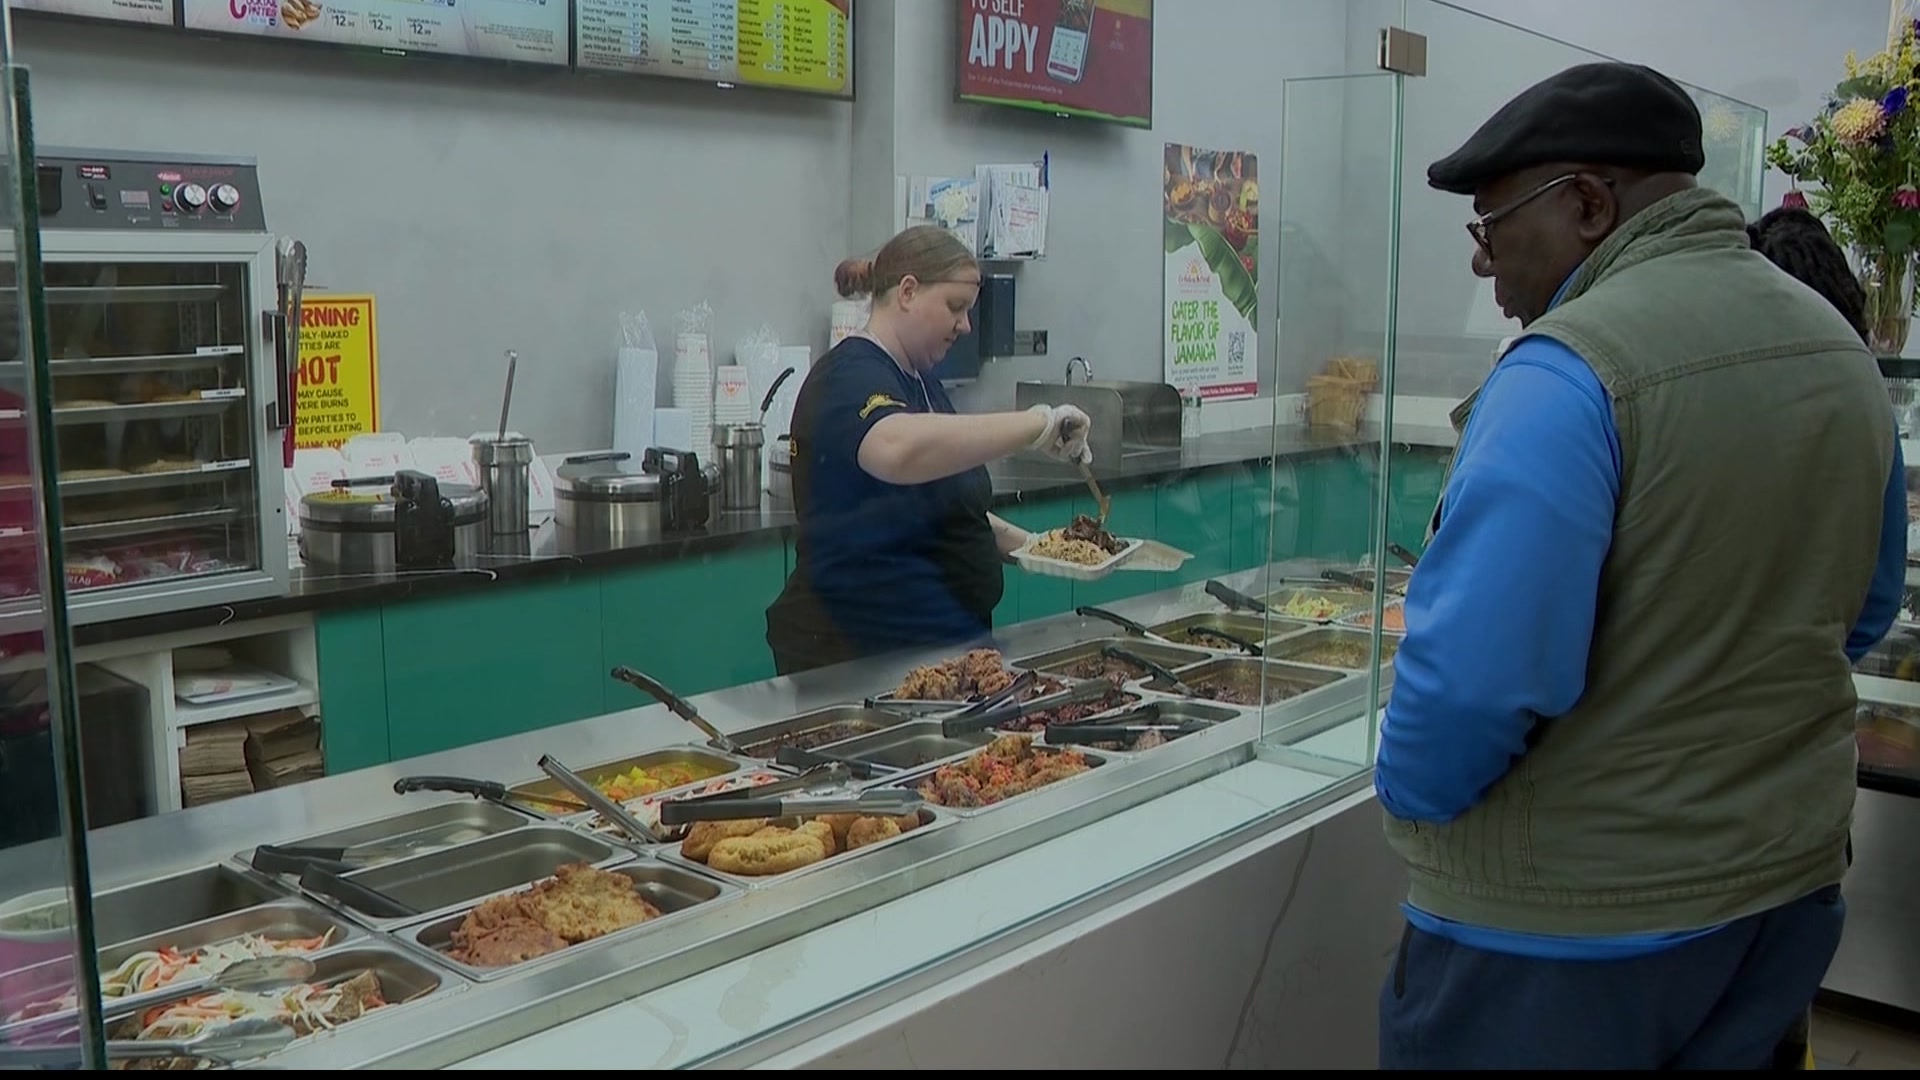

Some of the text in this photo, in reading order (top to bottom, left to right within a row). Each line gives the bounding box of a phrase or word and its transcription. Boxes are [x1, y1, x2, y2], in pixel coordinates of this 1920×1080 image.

[992, 0, 1024, 17] SELF
[968, 13, 1039, 73] APPY
[300, 306, 361, 328] RNING
[1172, 300, 1218, 319] CATER THE
[300, 330, 349, 339] HLY-BAKED
[1171, 320, 1219, 342] FLAVOR OF
[299, 341, 341, 350] TTIES ARE
[1174, 342, 1217, 365] JAMAICA
[298, 388, 344, 399] MAY CAUSE
[296, 398, 349, 410] VERE BURNS
[311, 414, 344, 423] PATTIES
[345, 412, 357, 421] TO
[298, 422, 362, 435] BEFORE EATING
